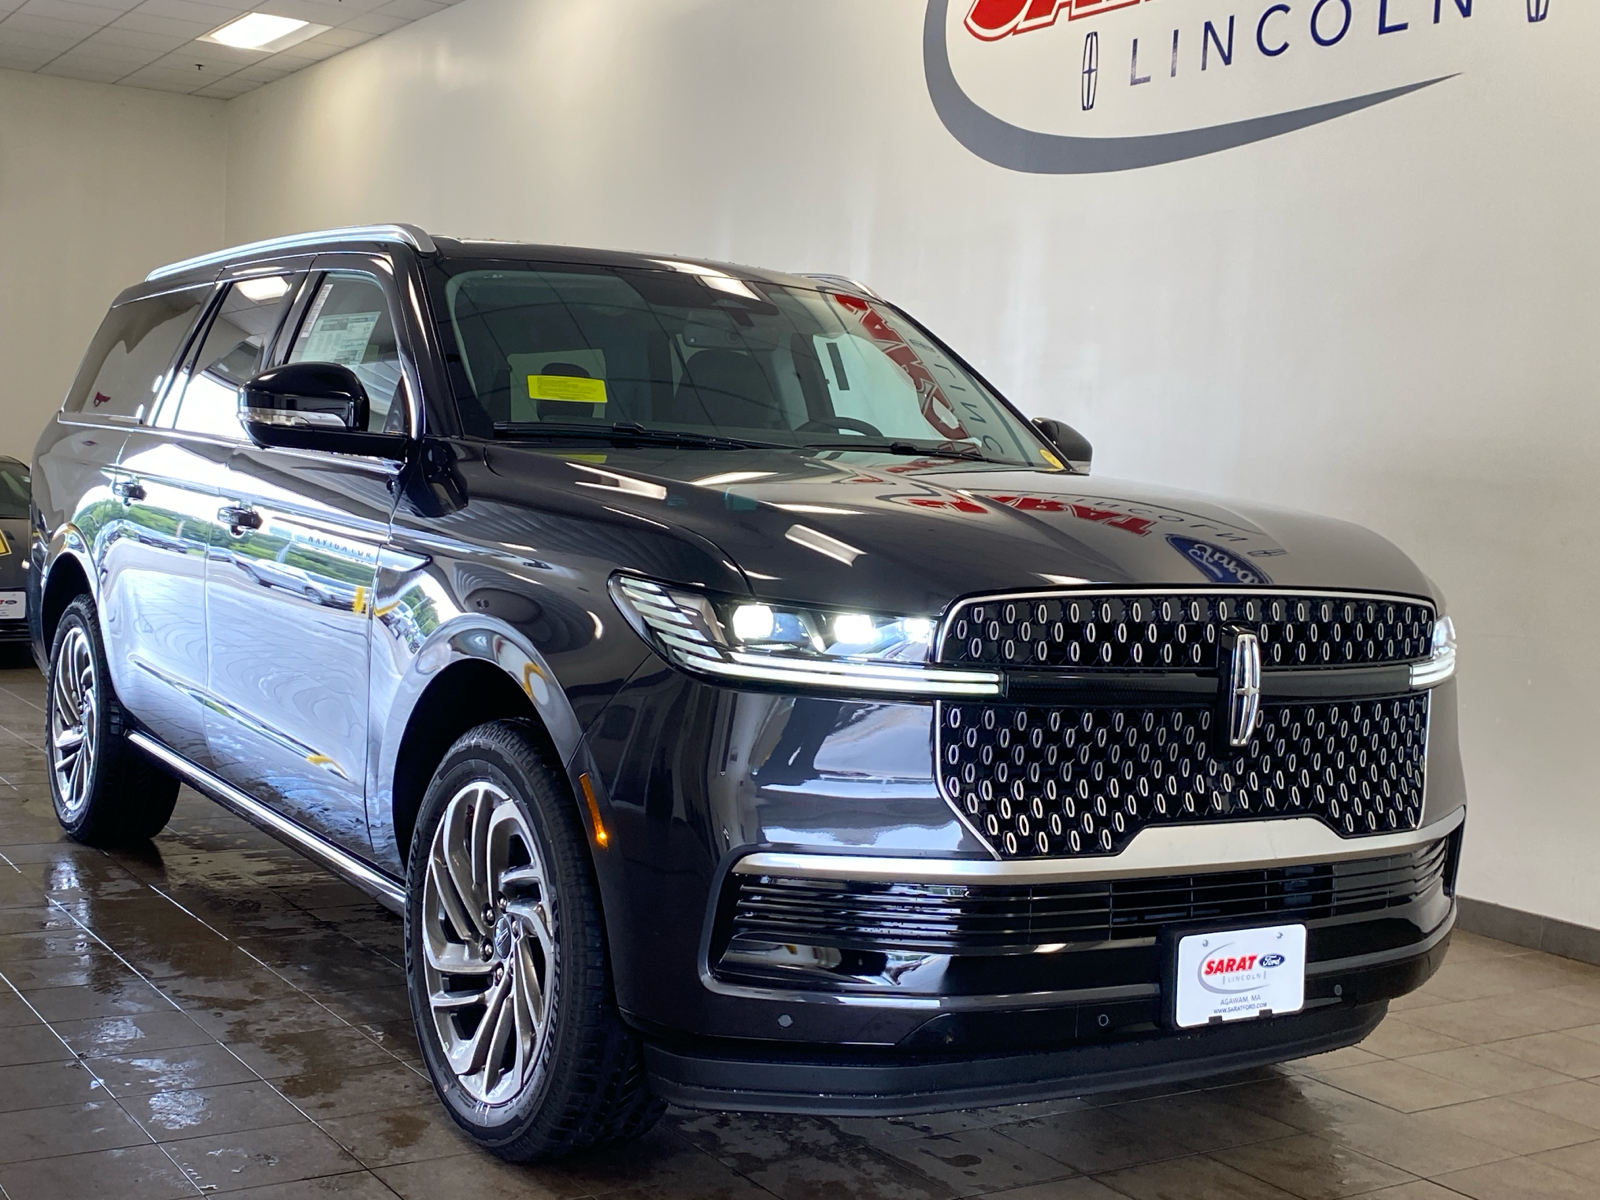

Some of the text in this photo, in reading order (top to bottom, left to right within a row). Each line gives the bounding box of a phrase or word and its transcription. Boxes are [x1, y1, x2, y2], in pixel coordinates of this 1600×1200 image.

[1204, 954, 1258, 976] SARAT
[1227, 973, 1261, 983] LINCOLN
[543, 941, 561, 1065] MICHELIN
